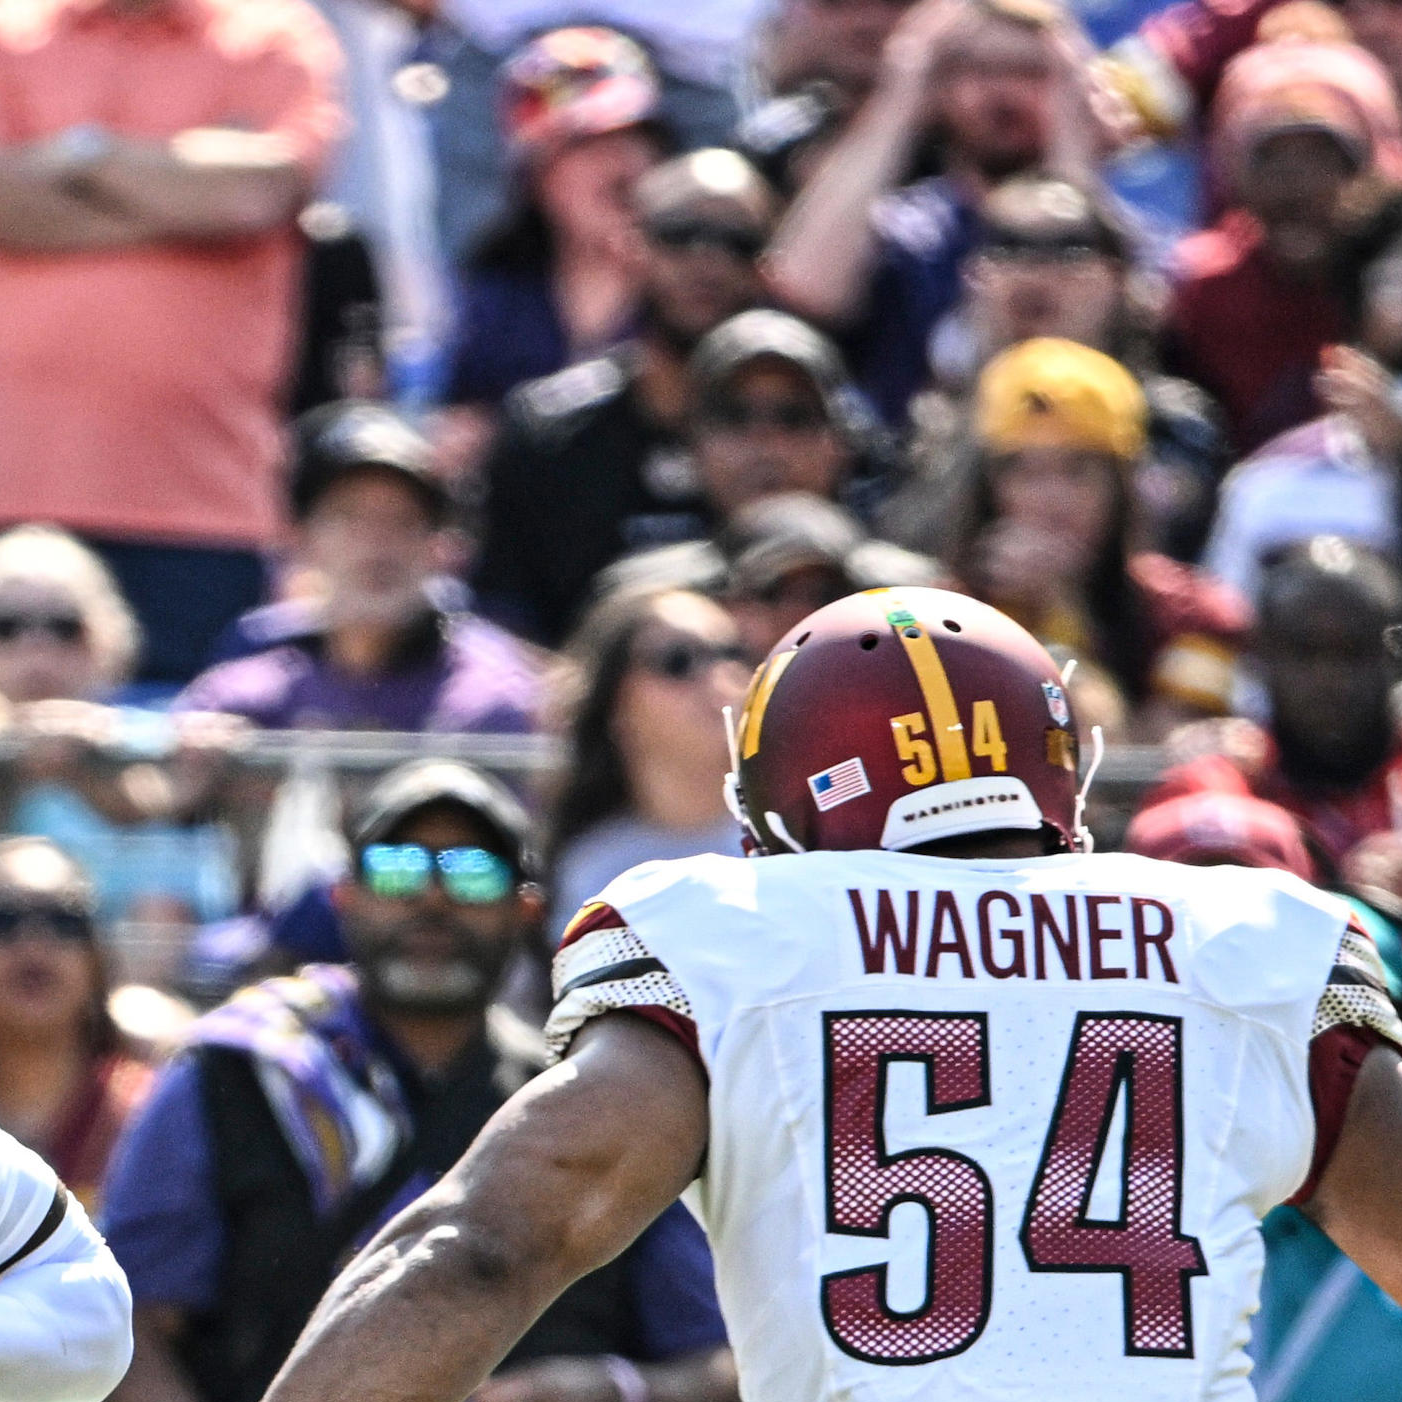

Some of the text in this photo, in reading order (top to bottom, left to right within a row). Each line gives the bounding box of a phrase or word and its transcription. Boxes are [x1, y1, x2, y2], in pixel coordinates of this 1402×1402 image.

[890, 700, 1007, 786] 54
[903, 794, 1019, 822] WASHINGTON
[847, 889, 1180, 984] WAGNER
[821, 1009, 1209, 1366] 54
